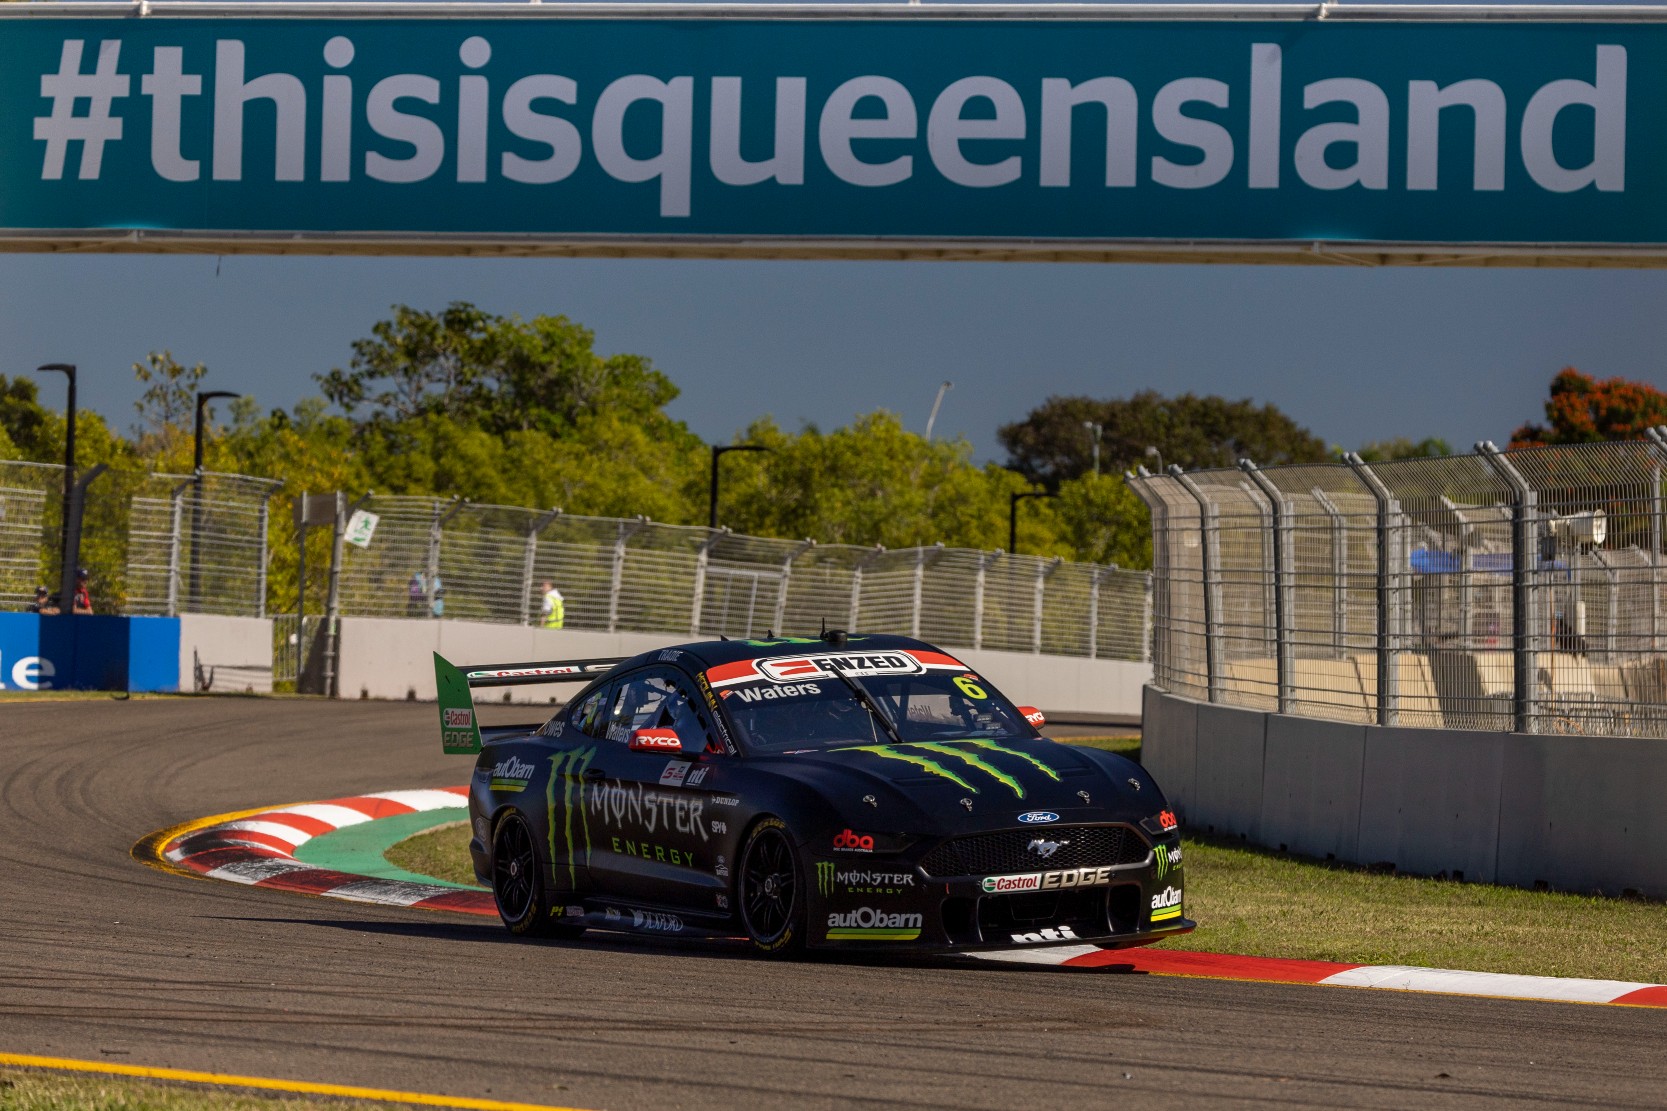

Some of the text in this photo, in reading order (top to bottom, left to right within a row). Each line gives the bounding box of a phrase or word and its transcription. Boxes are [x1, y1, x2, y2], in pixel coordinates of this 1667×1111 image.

[31, 36, 1628, 219] #thisisqueensland
[496, 667, 572, 678] Castrol
[812, 655, 908, 672] ENZED
[734, 683, 822, 703] Waters
[952, 676, 988, 700] 6
[443, 710, 474, 748] Castrol EDGE
[635, 735, 681, 746] RYCO
[590, 778, 709, 842] MONSTER
[715, 796, 740, 807] DUNLOP
[1026, 812, 1052, 822] Ford
[833, 828, 874, 849] dba
[612, 836, 694, 868] ENERGY
[836, 869, 916, 886] MONSTER
[996, 867, 1112, 891] Castrol EDGE
